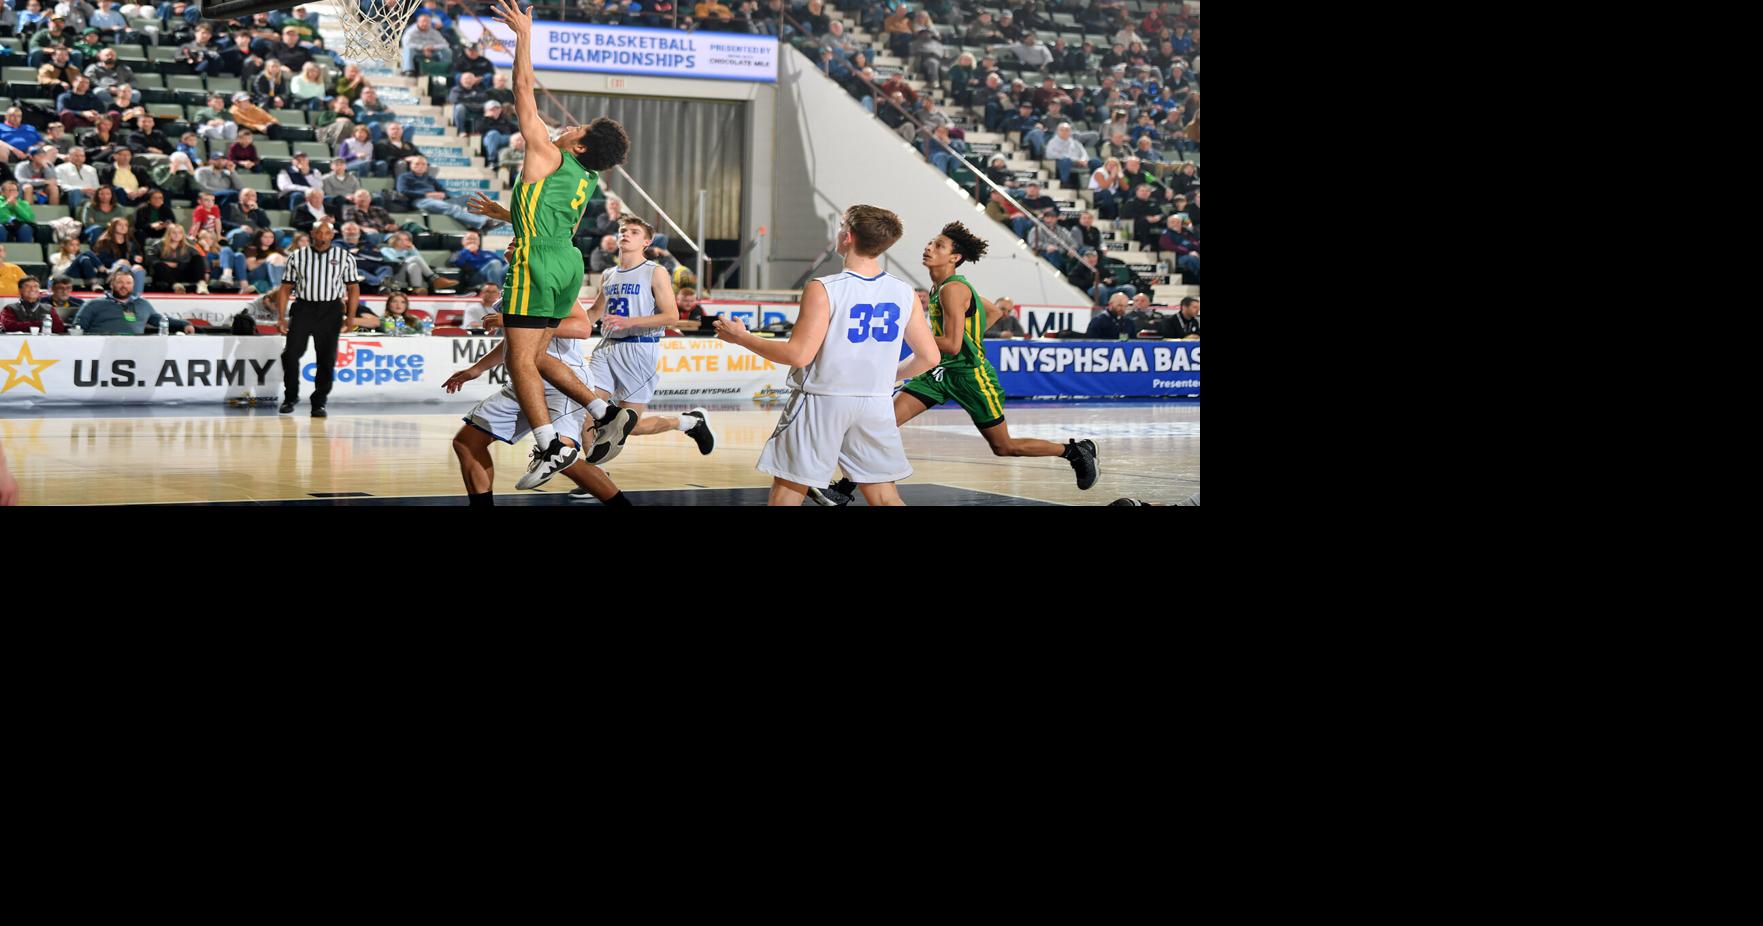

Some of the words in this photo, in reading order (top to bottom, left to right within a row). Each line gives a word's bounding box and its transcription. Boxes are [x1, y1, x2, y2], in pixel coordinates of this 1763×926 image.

[549, 31, 591, 45] BOYS
[595, 33, 697, 51] BASKETBALL
[548, 47, 696, 69] CHAMPIONSHIPS
[709, 58, 752, 66] CHOCOLATE
[570, 179, 588, 210] 5
[621, 284, 640, 295] FIELD
[608, 297, 630, 317] 23
[847, 302, 901, 343] 33
[689, 340, 724, 350] WITH
[356, 348, 425, 368] Price
[1000, 347, 1149, 372] NYSPHSAA
[1154, 347, 1200, 371] BAS
[73, 359, 146, 387] U.S.
[154, 359, 276, 387] ARMY
[302, 362, 424, 386] Copper
[702, 387, 741, 395] NYSPHSAA
[1153, 379, 1200, 388] Presente
